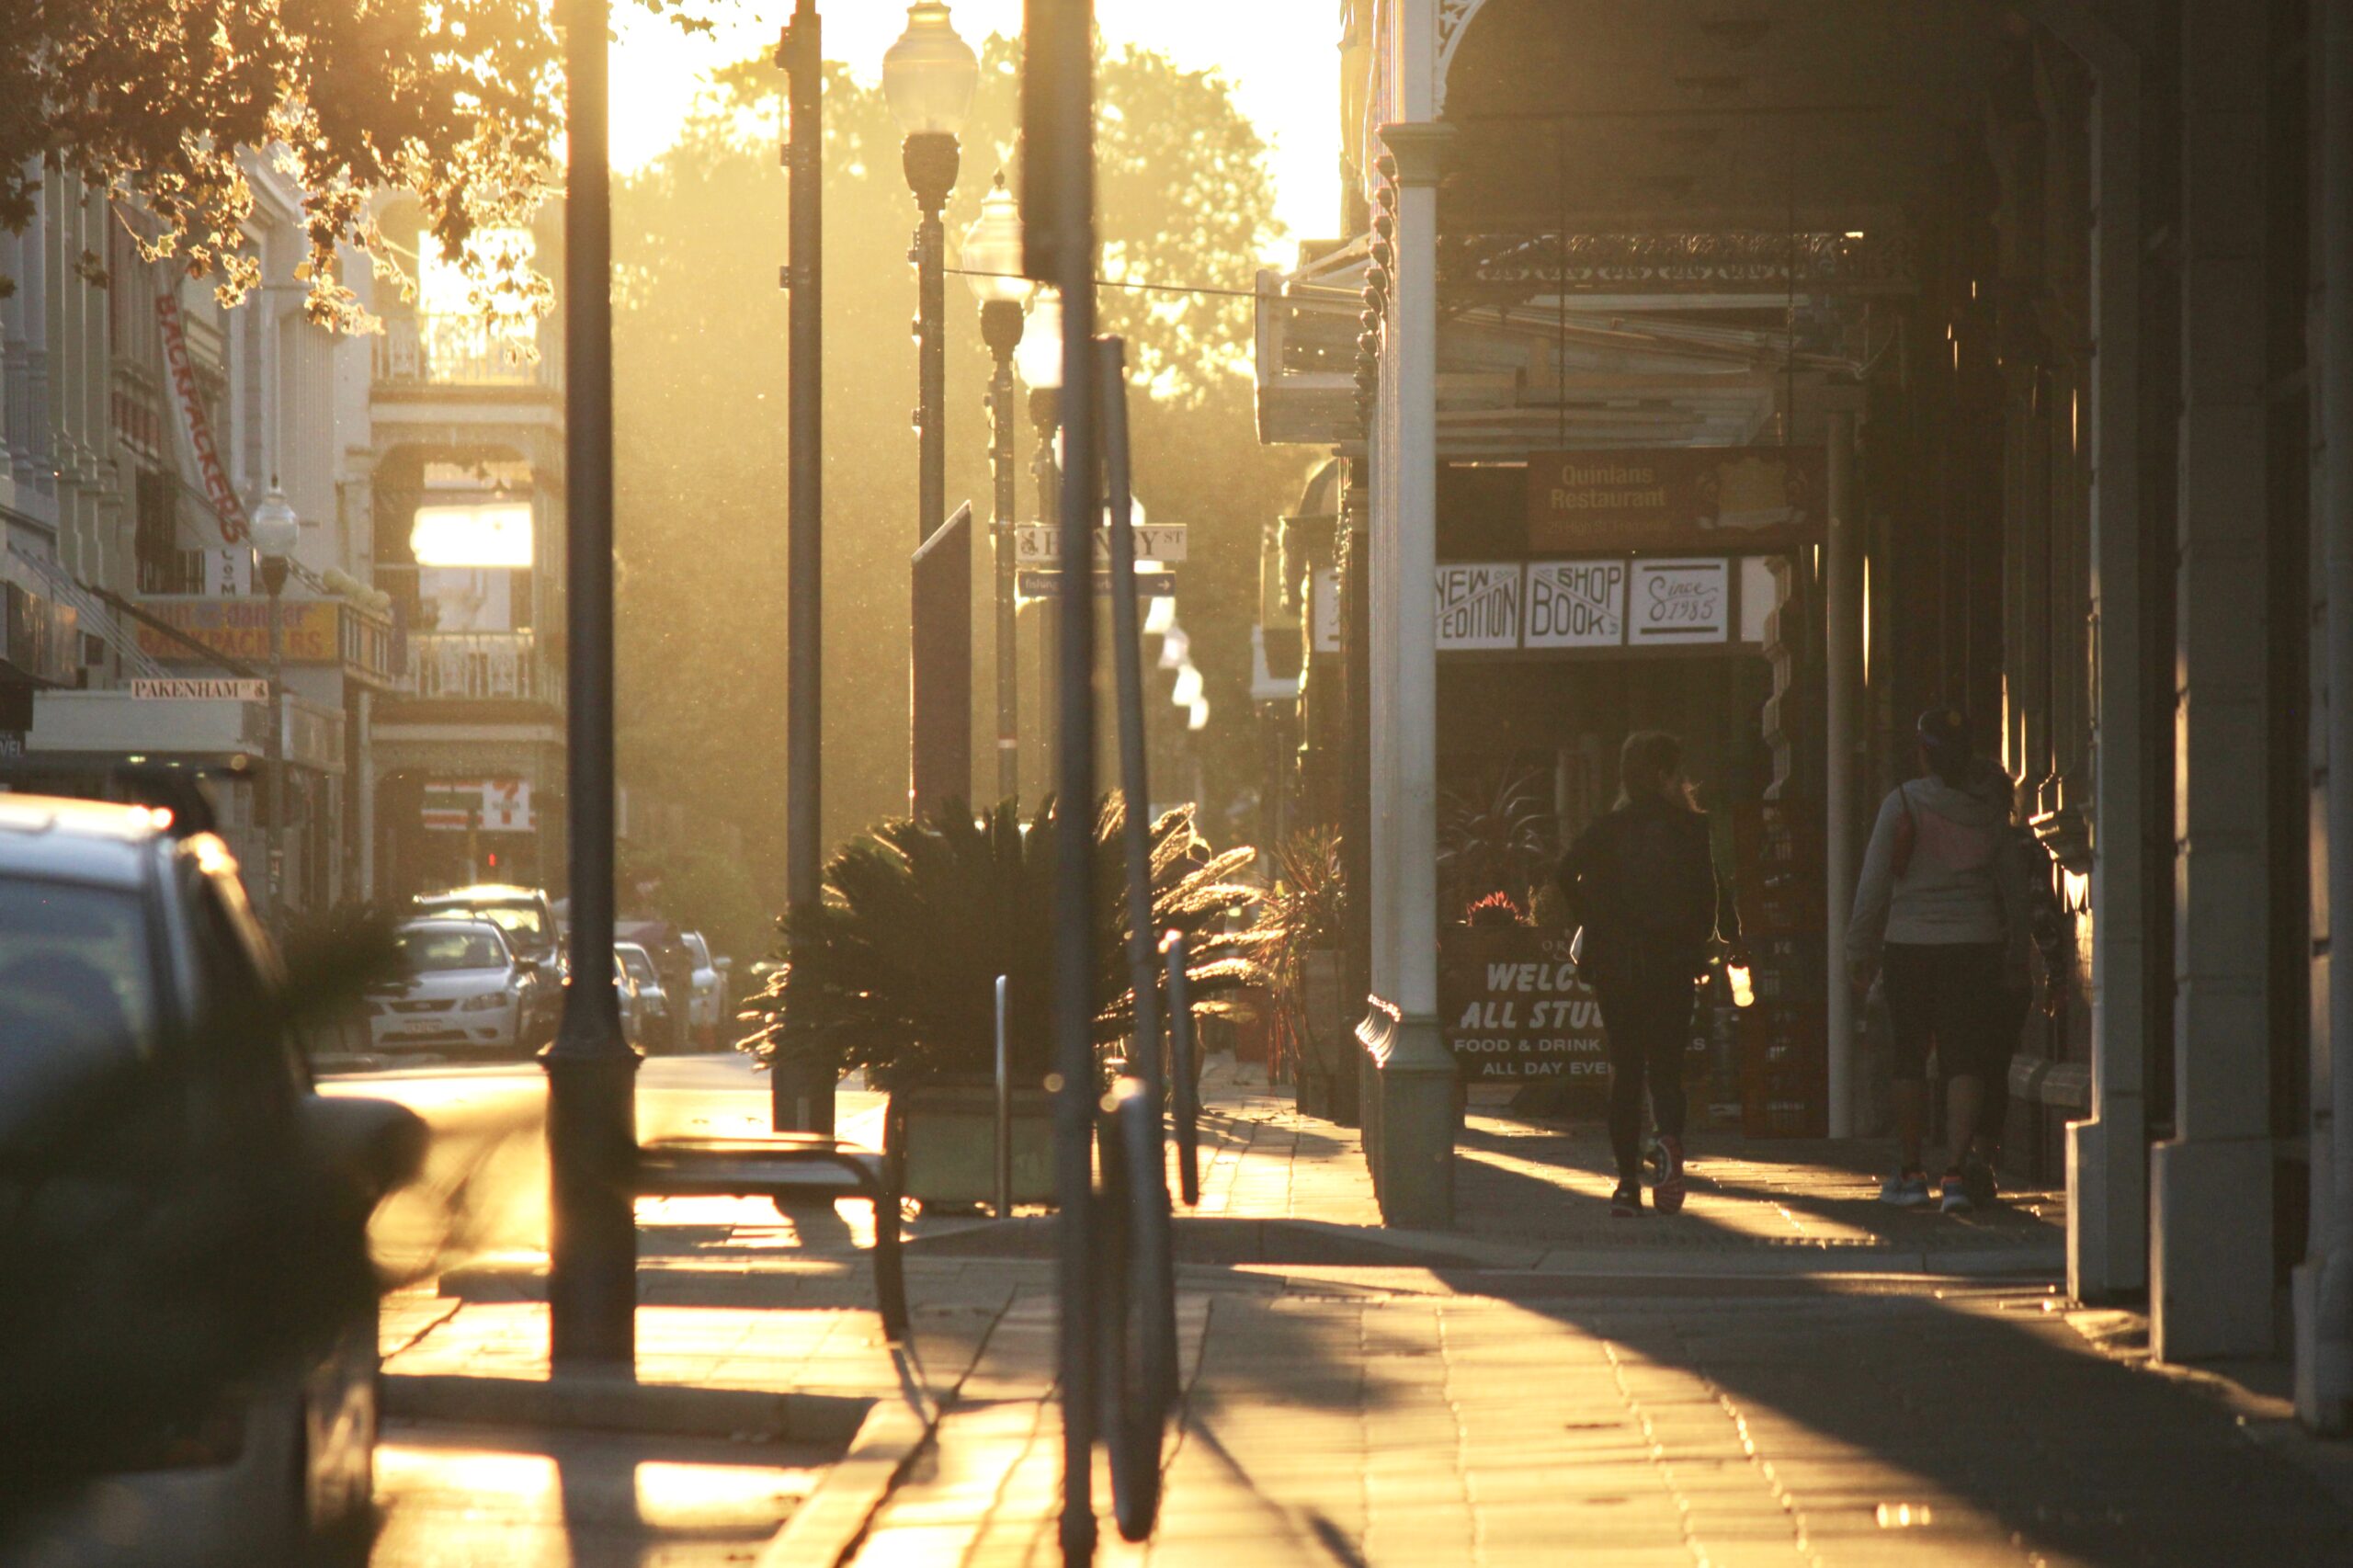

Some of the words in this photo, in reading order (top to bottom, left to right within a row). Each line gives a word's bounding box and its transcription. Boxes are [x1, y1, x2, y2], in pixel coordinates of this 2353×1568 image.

[155, 293, 249, 544] BACKPACKERS
[1561, 464, 1654, 486] Quinlans
[1551, 487, 1666, 509] Restaurant
[1043, 530, 1158, 556] HNY
[1164, 531, 1184, 543] ST
[1435, 569, 1489, 610] NEW
[1557, 566, 1621, 609] SHOP
[1648, 575, 1719, 621] Since
[1441, 574, 1518, 639] EDITION
[1530, 578, 1605, 636] BOOK
[1662, 597, 1716, 620] 1985
[134, 681, 238, 698] PAKENHAM
[492, 778, 519, 825] 7
[1486, 962, 1593, 993] WELC
[1460, 1001, 1518, 1029] ALL
[1454, 1039, 1511, 1052] FOOD
[1518, 1039, 1531, 1051] &
[1483, 1062, 1517, 1074] ALL
[1525, 1062, 1563, 1074] DAY
